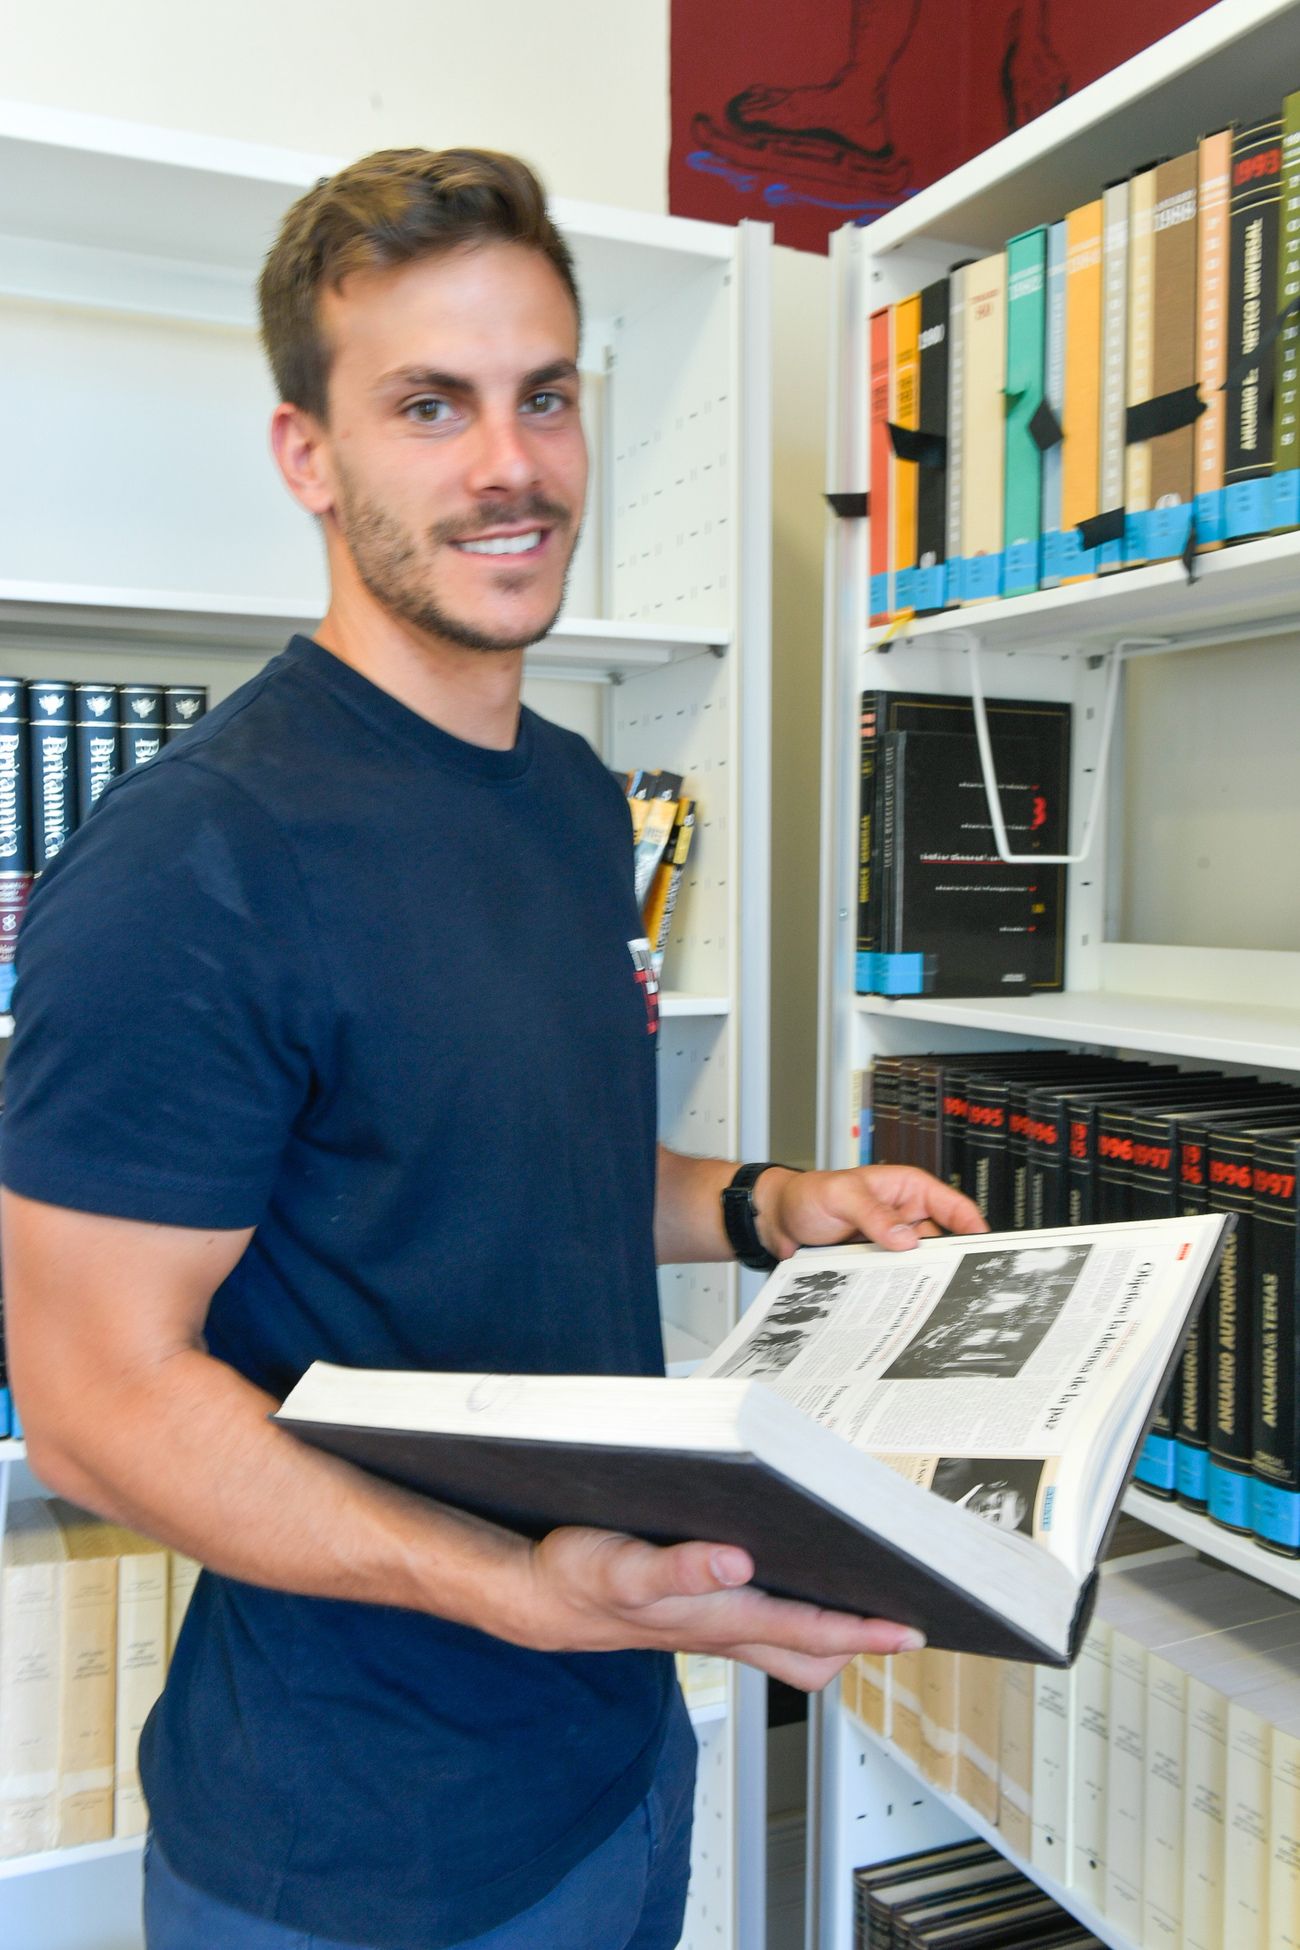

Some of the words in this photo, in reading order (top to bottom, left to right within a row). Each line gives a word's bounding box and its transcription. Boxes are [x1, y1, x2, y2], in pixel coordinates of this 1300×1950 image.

[1243, 217, 1264, 300] UNIVERSAL
[1240, 385, 1259, 450] ANUARIO
[42, 736, 69, 859] Britannica
[2, 913, 17, 931] 8
[1209, 1159, 1251, 1188] 1996
[1253, 1168, 1295, 1198] 1997
[1218, 1231, 1239, 1351] AUTONÓMICO
[1262, 1272, 1279, 1331] TEMAS
[1080, 1333, 1118, 1373] defensa
[1109, 1320, 1127, 1330] la
[1059, 1394, 1079, 1404] la
[1069, 1377, 1088, 1390] de
[1183, 1354, 1199, 1431] ANUARIO
[1217, 1352, 1236, 1435] ANUARIO
[1261, 1348, 1278, 1429] ANUARIO
